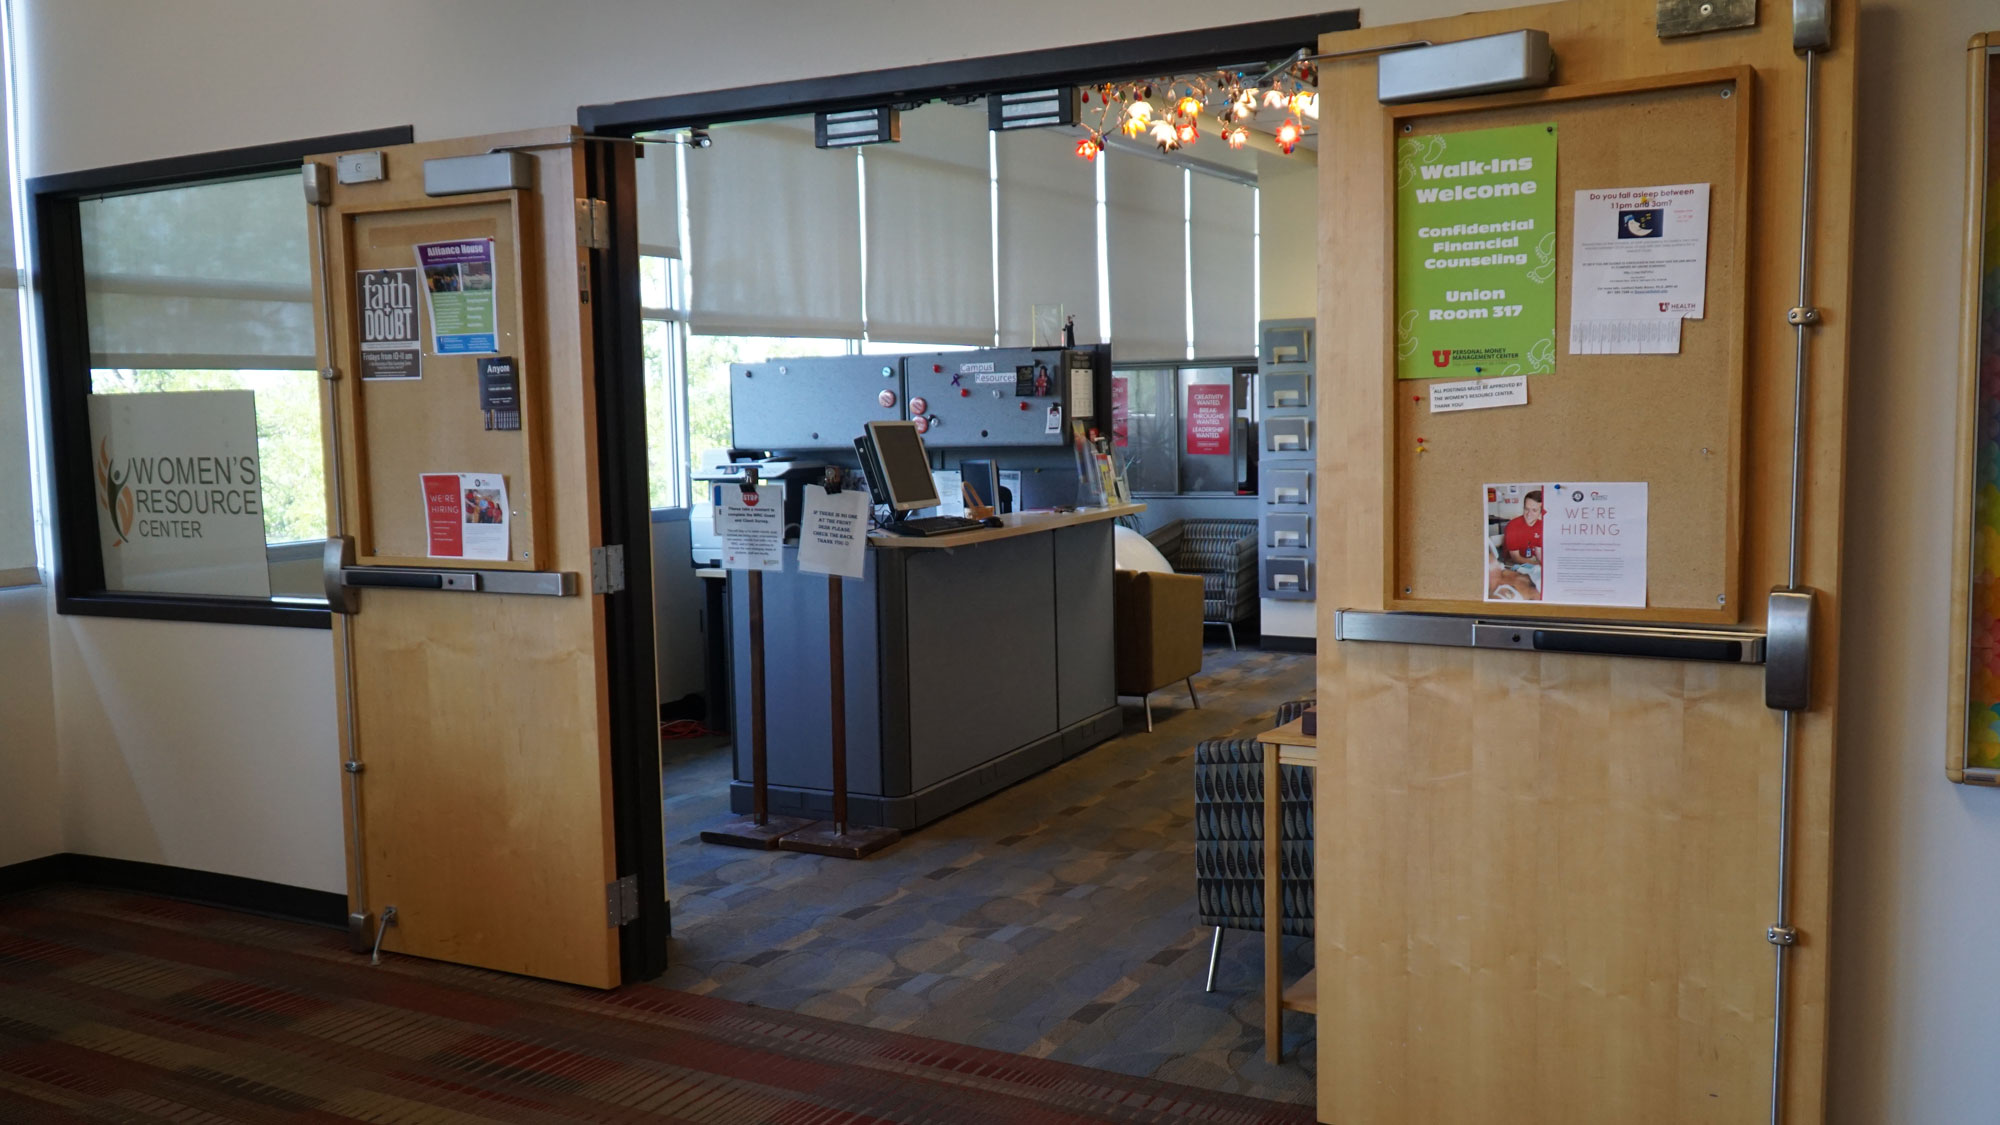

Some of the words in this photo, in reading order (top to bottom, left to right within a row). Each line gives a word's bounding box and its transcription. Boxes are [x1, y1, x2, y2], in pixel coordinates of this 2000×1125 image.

[1421, 157, 1532, 180] Walk-Ins
[1416, 181, 1537, 203] Welcome
[1633, 191, 1658, 199] asleep
[1661, 188, 1694, 196] between
[1418, 219, 1534, 238] Confidential
[427, 246, 460, 256] Alliance
[460, 244, 483, 254] House
[1433, 236, 1519, 253] Financial
[1424, 254, 1527, 269] Counseling
[363, 272, 412, 309] faith
[1446, 289, 1505, 302] Union
[1429, 308, 1488, 321] Room
[1493, 305, 1523, 317] 317
[364, 309, 412, 340] DOUBT
[960, 364, 993, 372] Campus
[975, 374, 1016, 382] Resources
[132, 456, 255, 485] WOMEN'S
[136, 490, 258, 515] RESOURCE
[430, 494, 455, 503] WE'RE
[431, 506, 459, 514] HIRING
[1565, 507, 1616, 519] WE'RE
[139, 520, 202, 538] CENTER
[1561, 524, 1620, 536] HIRING
